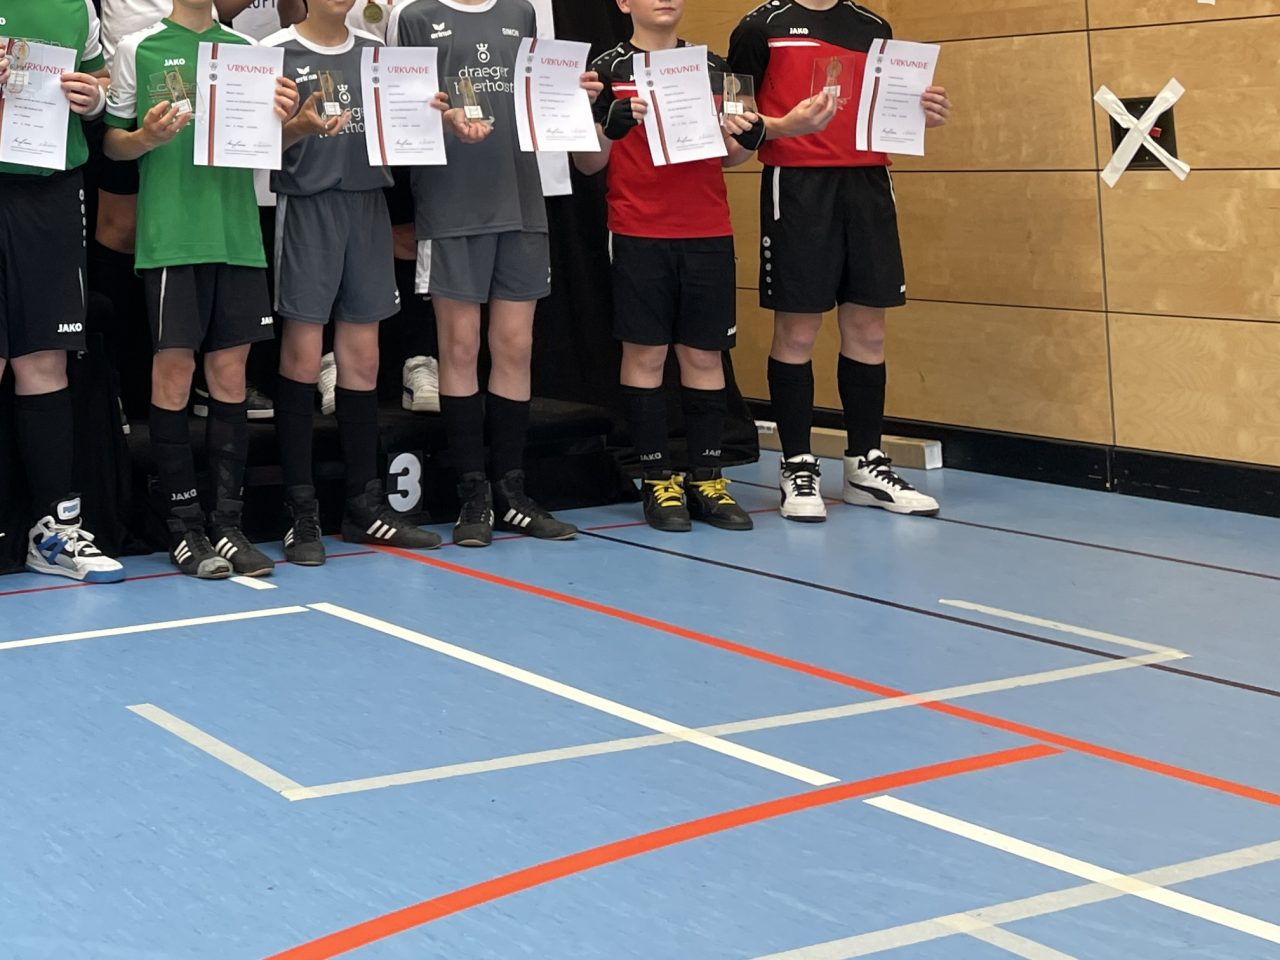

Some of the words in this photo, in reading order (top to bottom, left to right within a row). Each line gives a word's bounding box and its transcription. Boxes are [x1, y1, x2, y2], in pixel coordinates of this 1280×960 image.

[431, 29, 452, 39] erima
[789, 27, 809, 35] JAKO
[164, 58, 186, 67] JAKO
[541, 57, 579, 69] URKUNDE
[890, 57, 928, 70] URKUNDE
[227, 63, 276, 76] URKUNDE
[387, 65, 430, 75] URKUNDE
[459, 66, 510, 81] draeger
[659, 64, 701, 77] URKUNDE
[57, 322, 83, 333] JAKO
[387, 452, 422, 513] 3
[170, 488, 198, 501] JAKO
